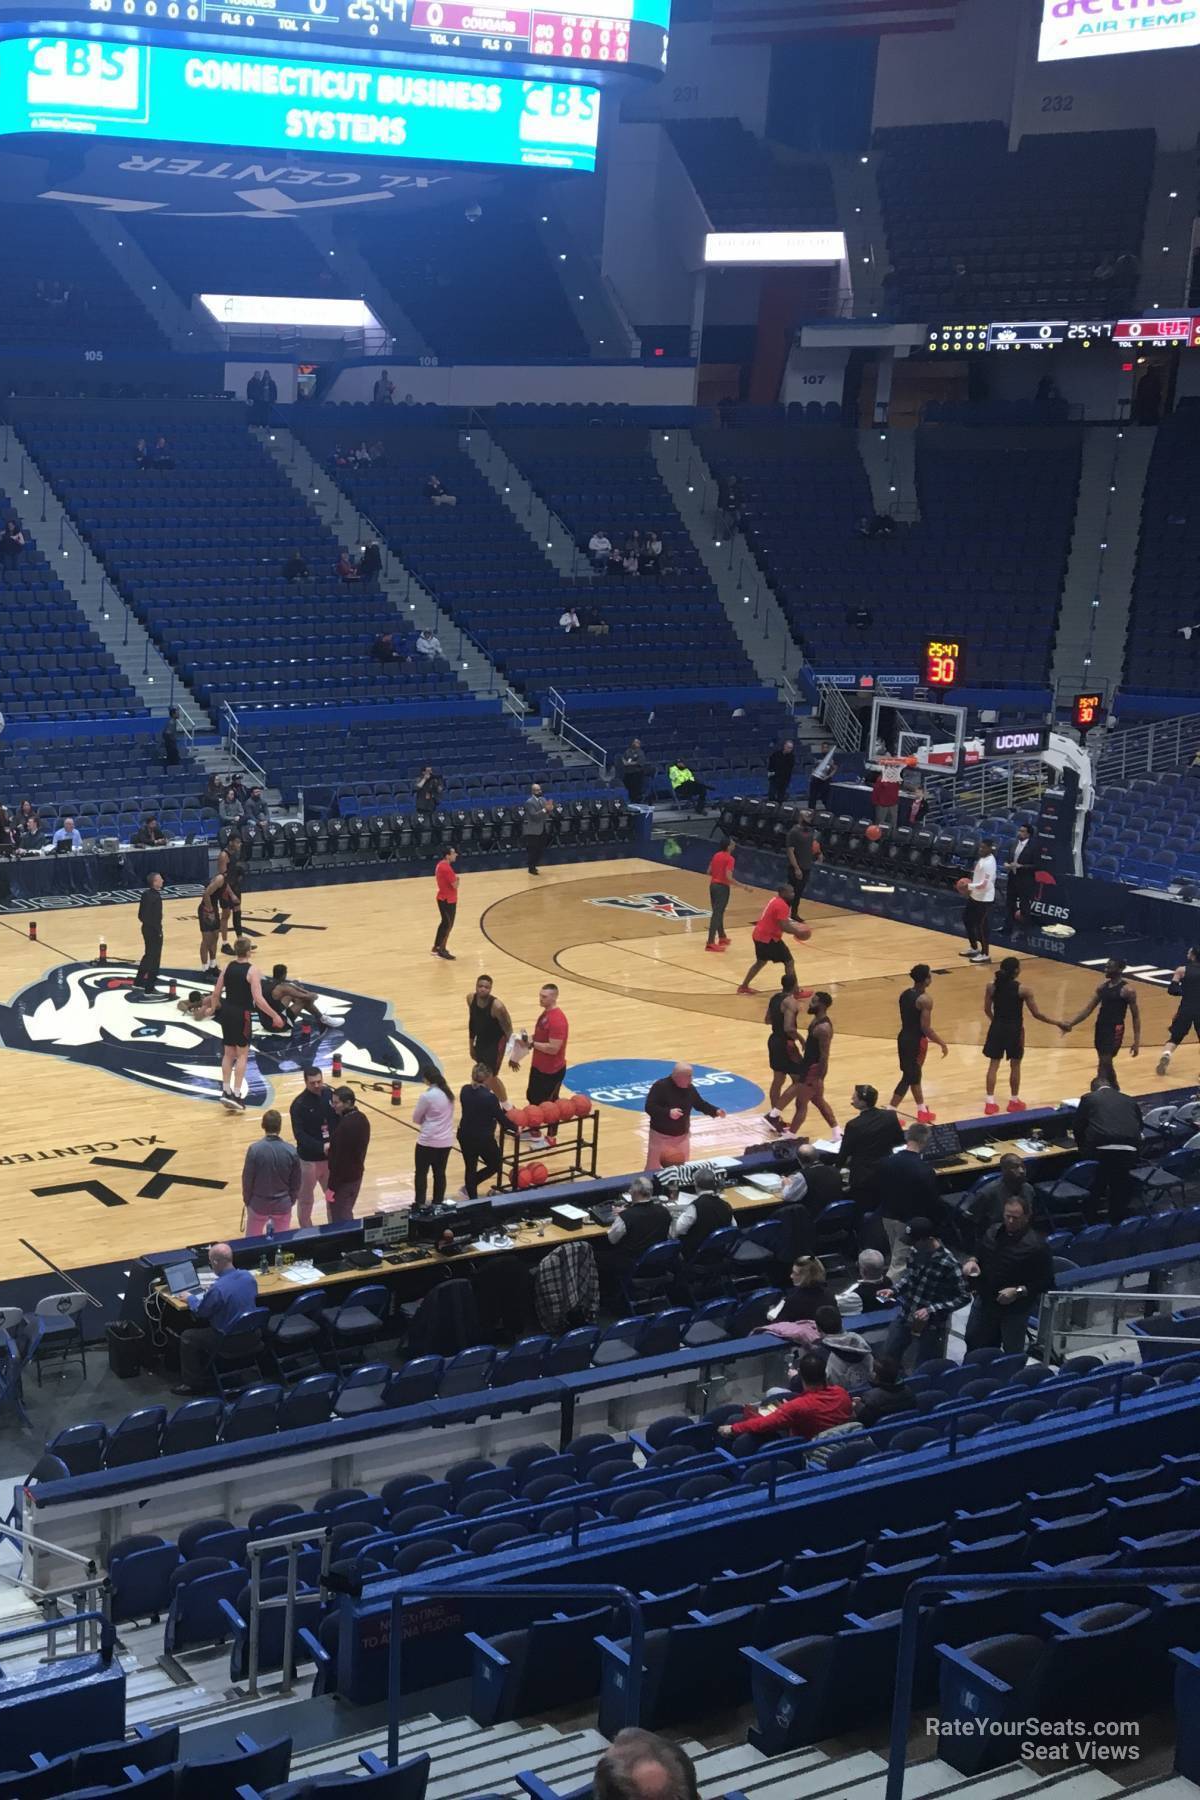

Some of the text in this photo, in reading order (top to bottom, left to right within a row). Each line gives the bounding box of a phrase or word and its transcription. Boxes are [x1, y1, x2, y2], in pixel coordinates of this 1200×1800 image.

[427, 3, 444, 26] 0
[1077, 11, 1196, 34] AIR TEMP
[185, 58, 502, 112] CONNECTICUT BUSINESS
[1042, 94, 1074, 112] 232
[284, 109, 407, 145] SYSTEMS
[118, 155, 363, 188] CENTER
[1040, 326, 1051, 338] 0
[1068, 324, 1112, 339] 25:47
[1129, 324, 1141, 336] 0
[84, 351, 104, 362] 105
[418, 357, 438, 368] 106
[802, 375, 826, 385] 107
[929, 642, 959, 657] 25:47
[932, 658, 954, 682] 30
[1080, 708, 1093, 722] 30
[996, 733, 1039, 749] UCONN
[590, 1071, 735, 1103] ges3D
